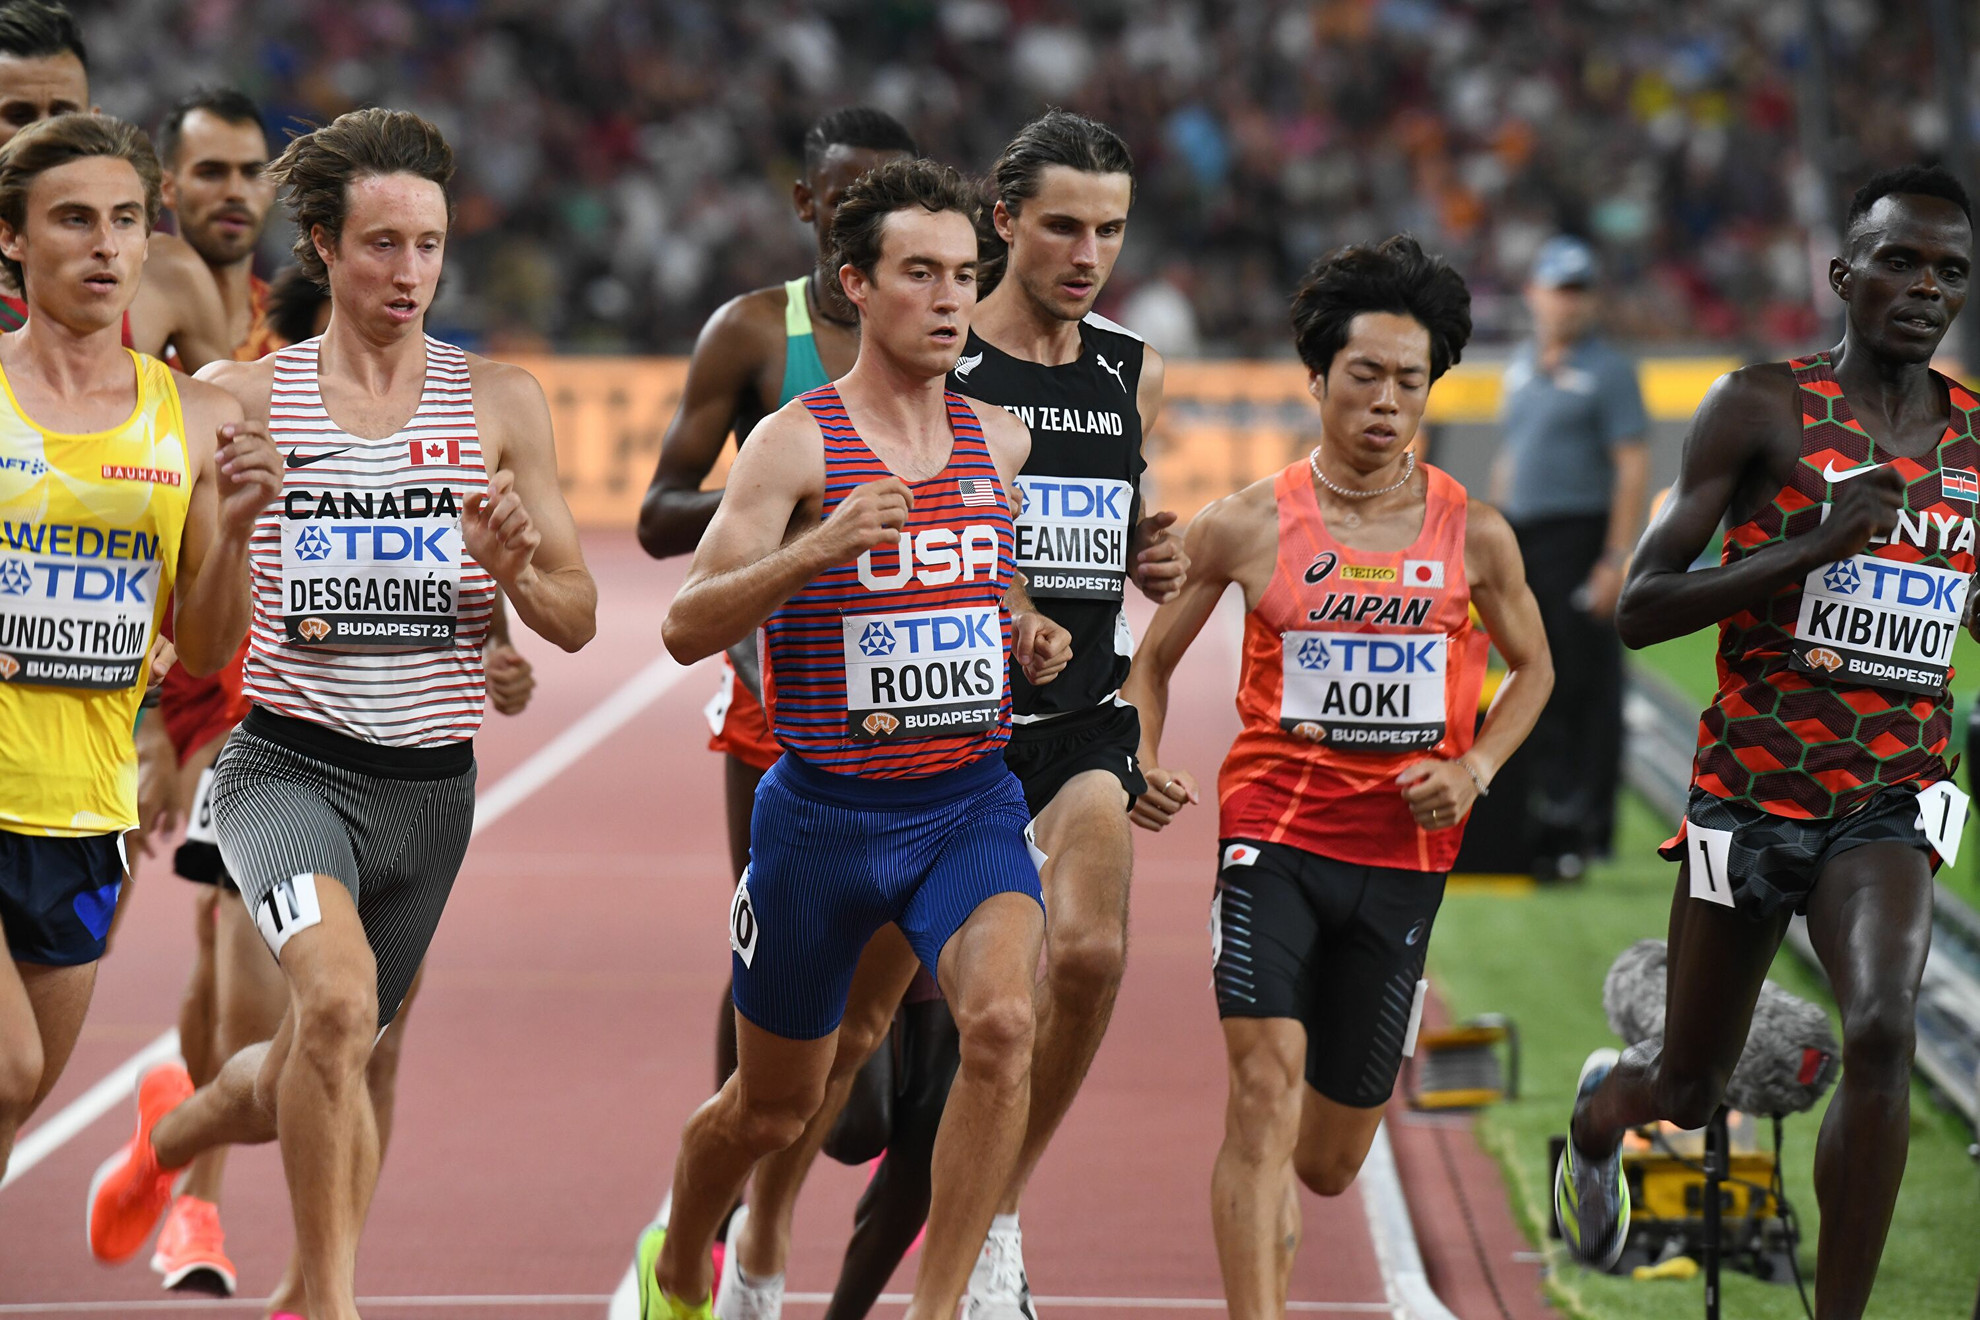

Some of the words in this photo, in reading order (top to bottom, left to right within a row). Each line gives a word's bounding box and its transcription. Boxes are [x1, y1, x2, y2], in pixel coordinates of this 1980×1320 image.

[1039, 407, 1123, 436] ZEALAND
[102, 465, 181, 486] BAUHAUS
[284, 487, 458, 520] CANADA
[1030, 482, 1122, 519] TDK
[0, 521, 160, 561] WEDEN
[331, 526, 450, 562] TDK
[1015, 525, 1121, 565] EAMISH
[1820, 503, 1976, 556] NYA
[857, 525, 999, 591] USA
[1342, 566, 1396, 580] SEIKO
[34, 562, 150, 603] TDK
[290, 572, 452, 613] DESGAGNÉS
[1863, 562, 1962, 613] TDK
[1309, 593, 1432, 627] JAPAN
[1807, 599, 1954, 660] KIBIWOT
[894, 613, 995, 654] TDK
[1330, 639, 1438, 674] TDK
[870, 658, 995, 704] ROOKS
[1321, 681, 1410, 718] AOKI
[1940, 790, 1951, 843] 1
[1699, 839, 1717, 892] 1
[263, 878, 300, 934] 11
